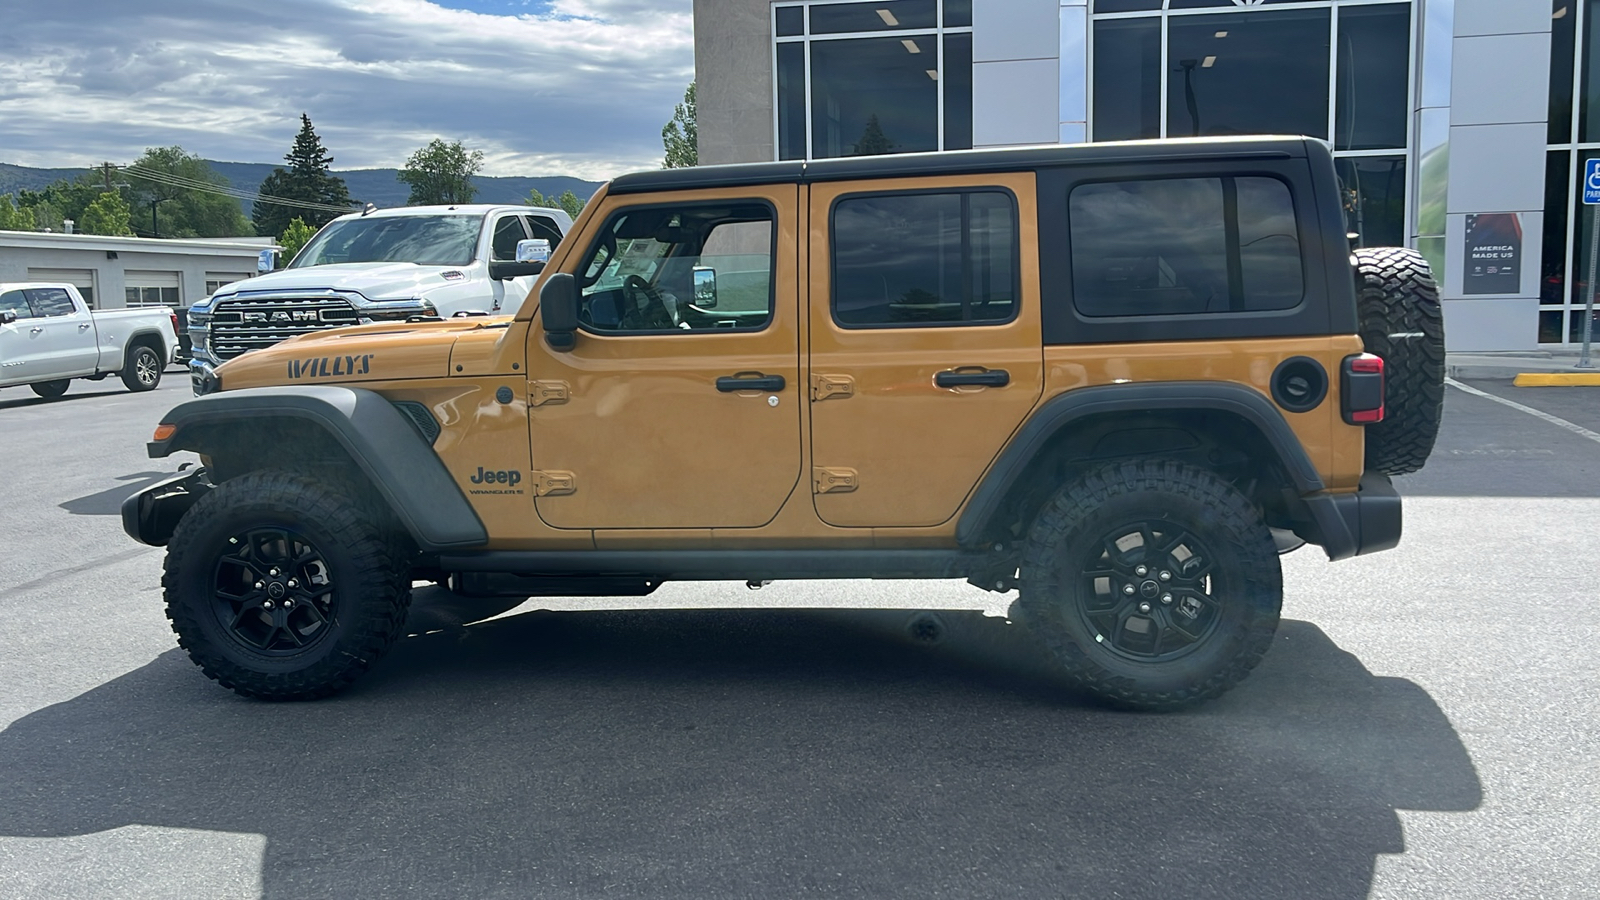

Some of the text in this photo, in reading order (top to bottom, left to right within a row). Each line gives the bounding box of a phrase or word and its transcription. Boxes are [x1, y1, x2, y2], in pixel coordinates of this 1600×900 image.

[244, 310, 317, 323] RAM
[288, 354, 374, 379] WILLYS
[470, 466, 521, 487] Jeep
